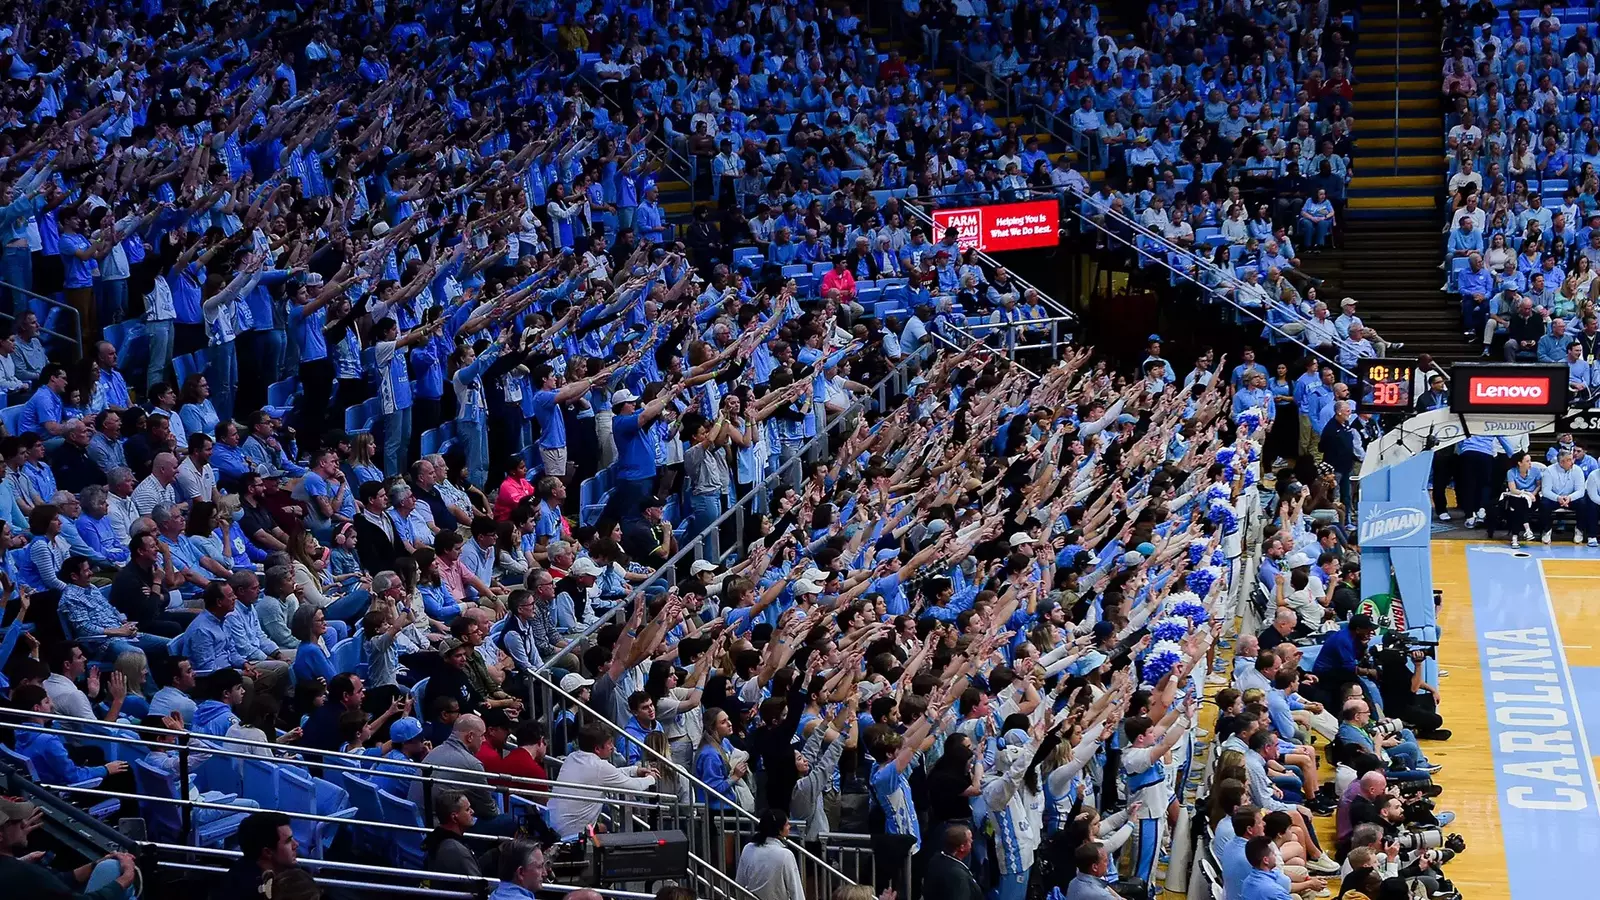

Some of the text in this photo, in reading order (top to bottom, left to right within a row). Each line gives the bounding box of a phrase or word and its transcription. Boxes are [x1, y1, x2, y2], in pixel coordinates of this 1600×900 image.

[948, 215, 977, 227] FARM
[996, 214, 1046, 227] Helping You Is
[937, 225, 978, 238] BEAU
[990, 224, 1052, 238] What We Do Best.
[1369, 365, 1410, 381] 10:11
[1374, 383, 1399, 404] 30
[1476, 382, 1542, 398] Lenovo
[1484, 420, 1535, 431] SPALDING
[1359, 512, 1424, 545] LIBMAN
[1484, 626, 1588, 811] CAROLINA
